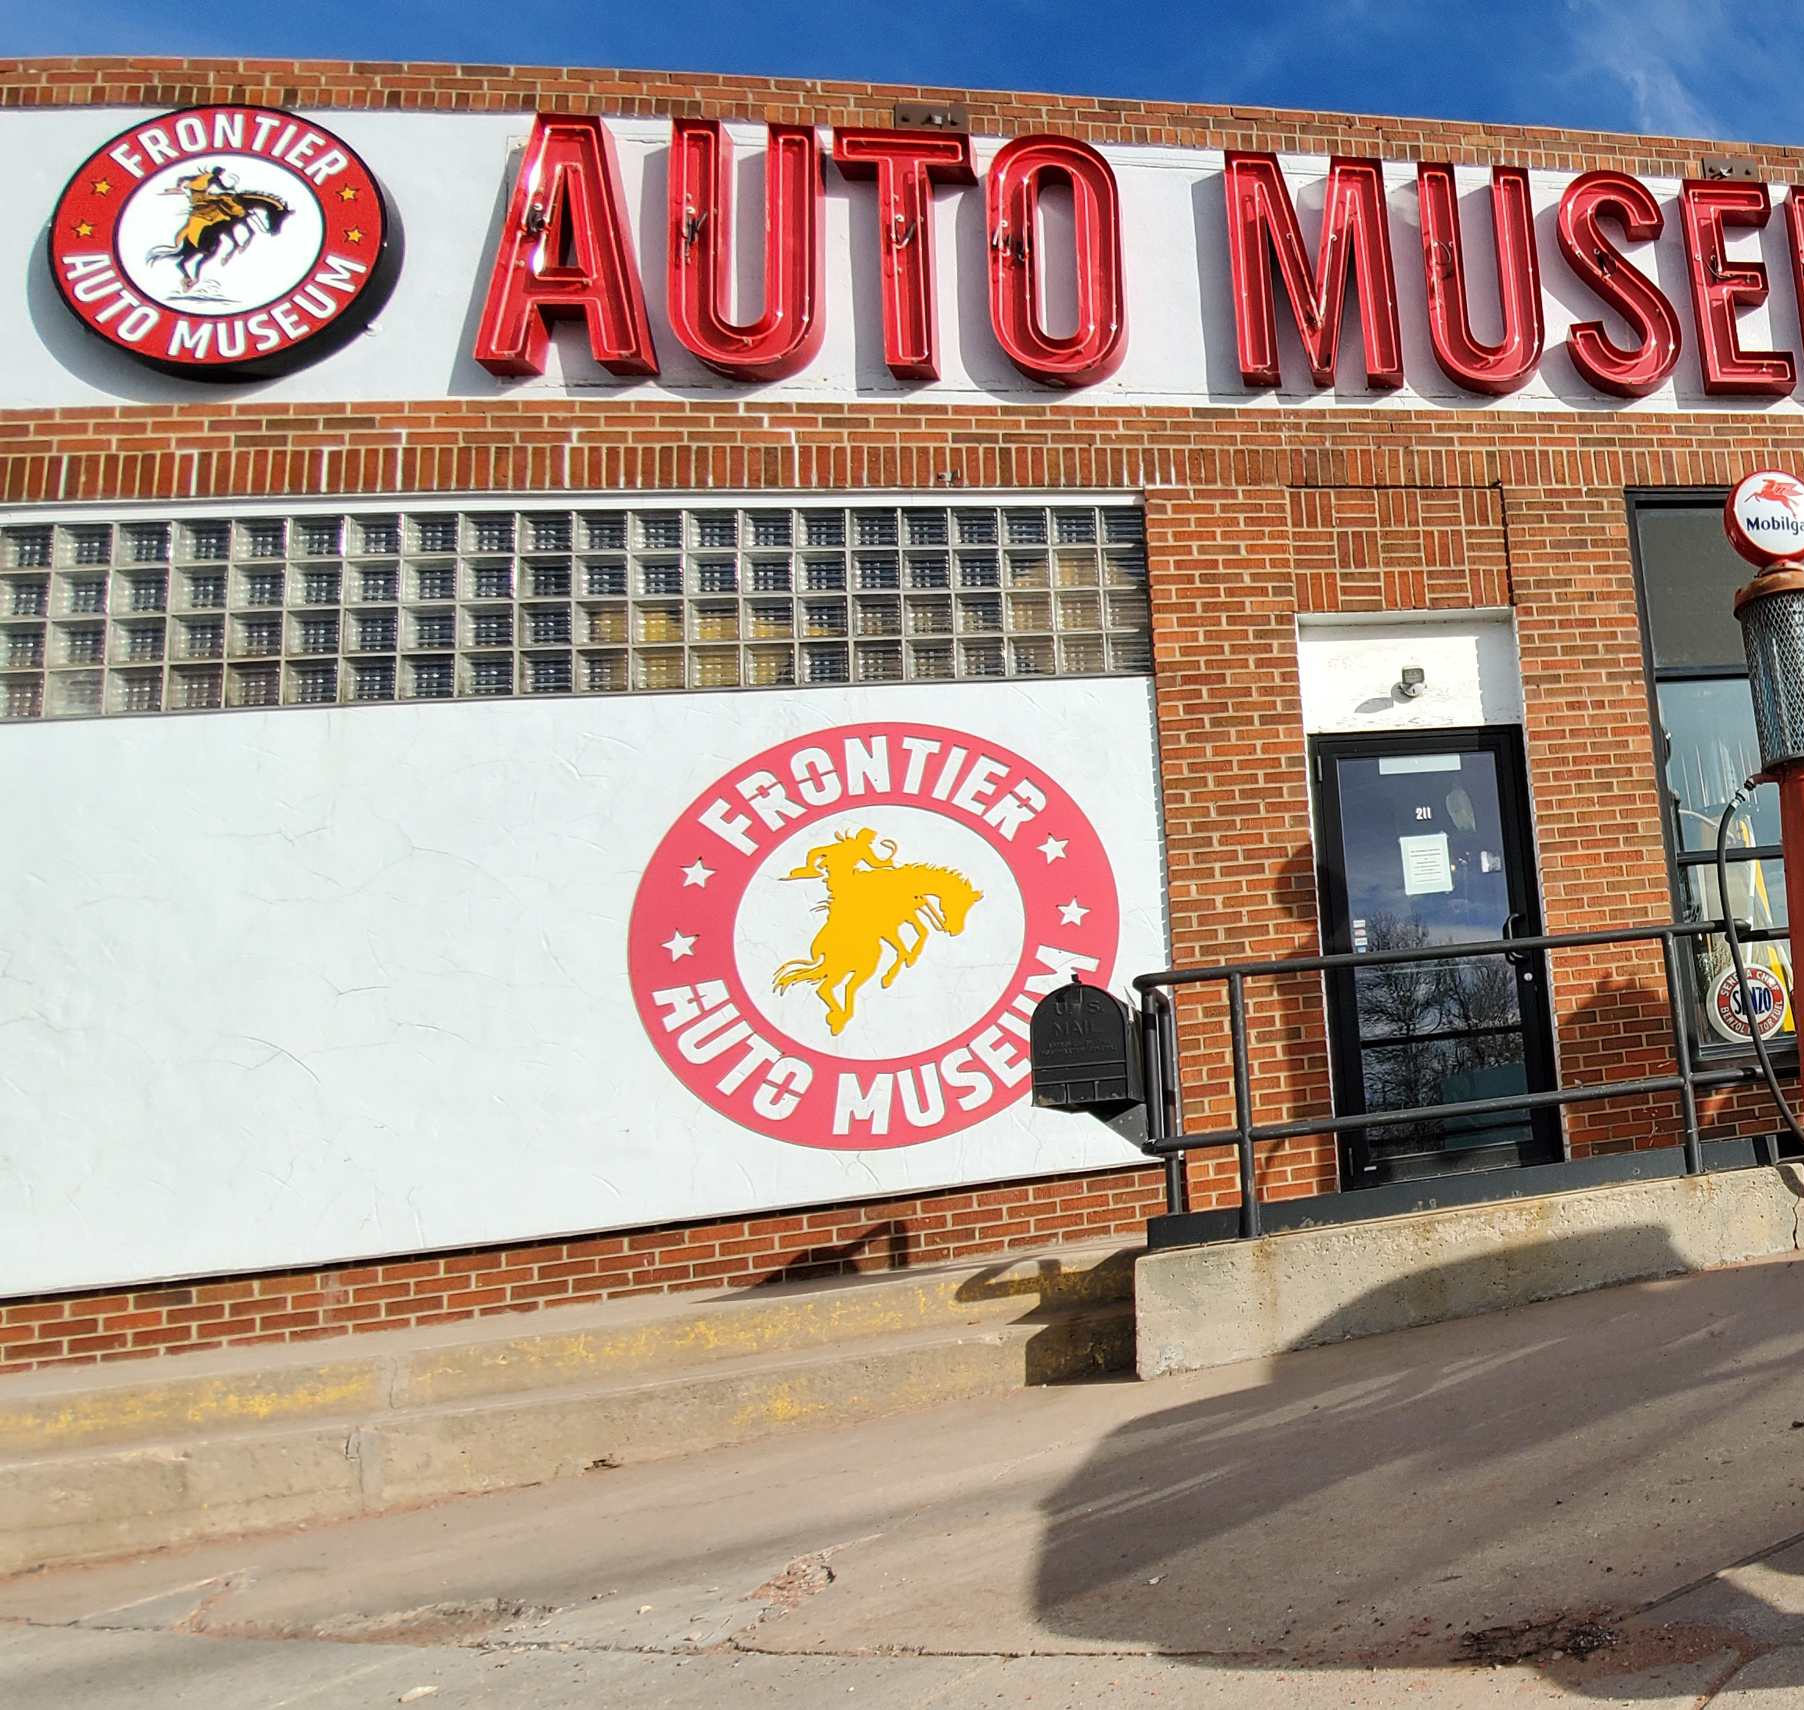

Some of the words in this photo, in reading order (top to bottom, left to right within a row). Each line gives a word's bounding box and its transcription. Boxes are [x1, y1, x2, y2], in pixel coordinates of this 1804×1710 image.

[109, 113, 349, 186] FRONTIER
[62, 253, 161, 343] AUTO
[167, 254, 368, 359] MUSEUM
[474, 113, 1128, 388] AUTO
[698, 735, 1048, 856] FRONTIER
[1416, 806, 1433, 820] 211
[652, 979, 813, 1120] AUTO
